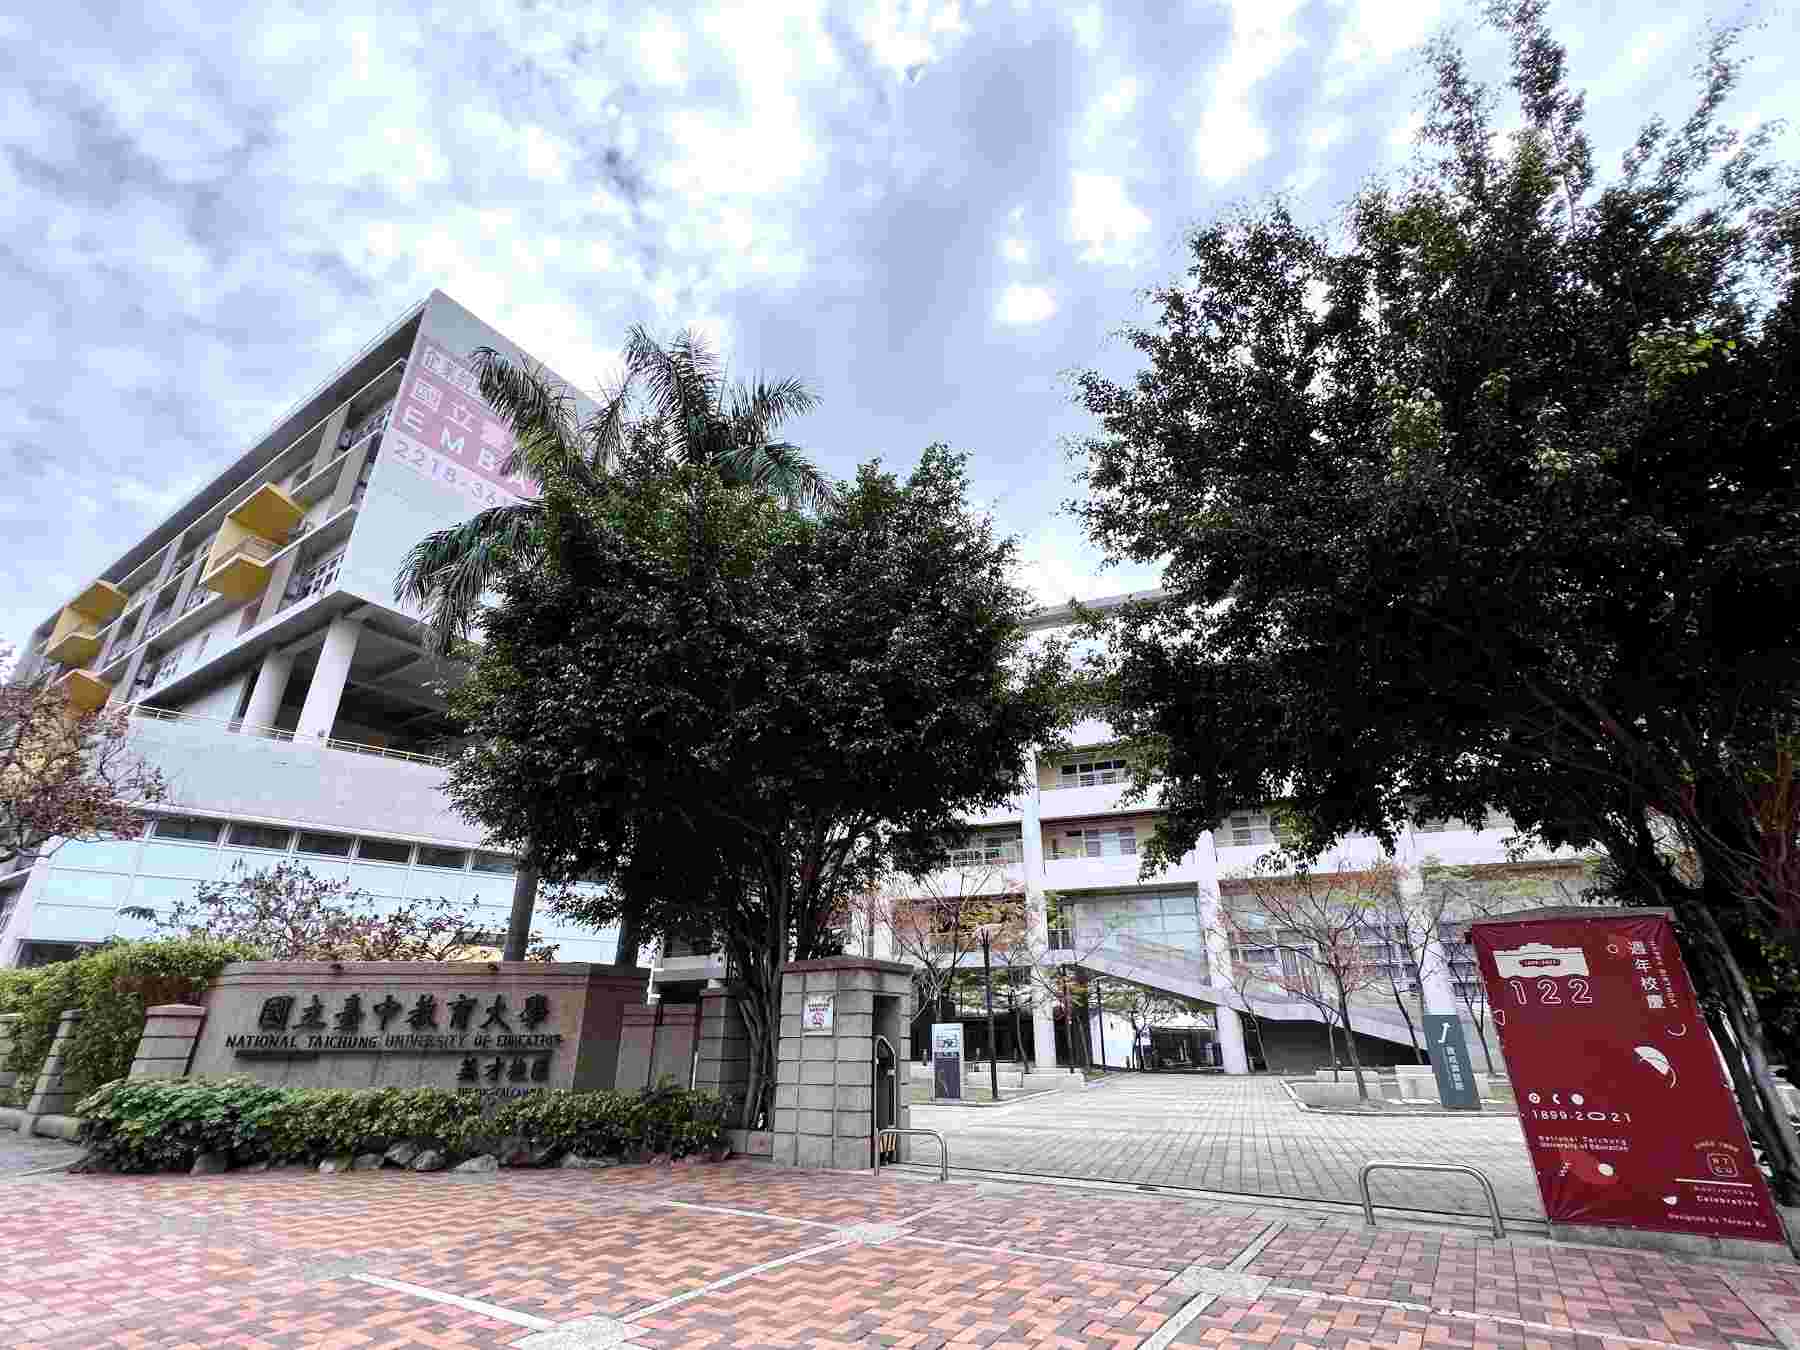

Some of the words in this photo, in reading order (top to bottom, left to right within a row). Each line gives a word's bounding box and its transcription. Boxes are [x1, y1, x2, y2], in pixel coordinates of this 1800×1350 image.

[1511, 978, 1593, 1005] 122
[258, 992, 550, 1031] 國立臺中教育大學
[225, 1034, 297, 1048] NATIONAL
[307, 1034, 377, 1049] TAICHUNG
[385, 1034, 468, 1049] UNIVERSITY
[474, 1034, 493, 1049] OF
